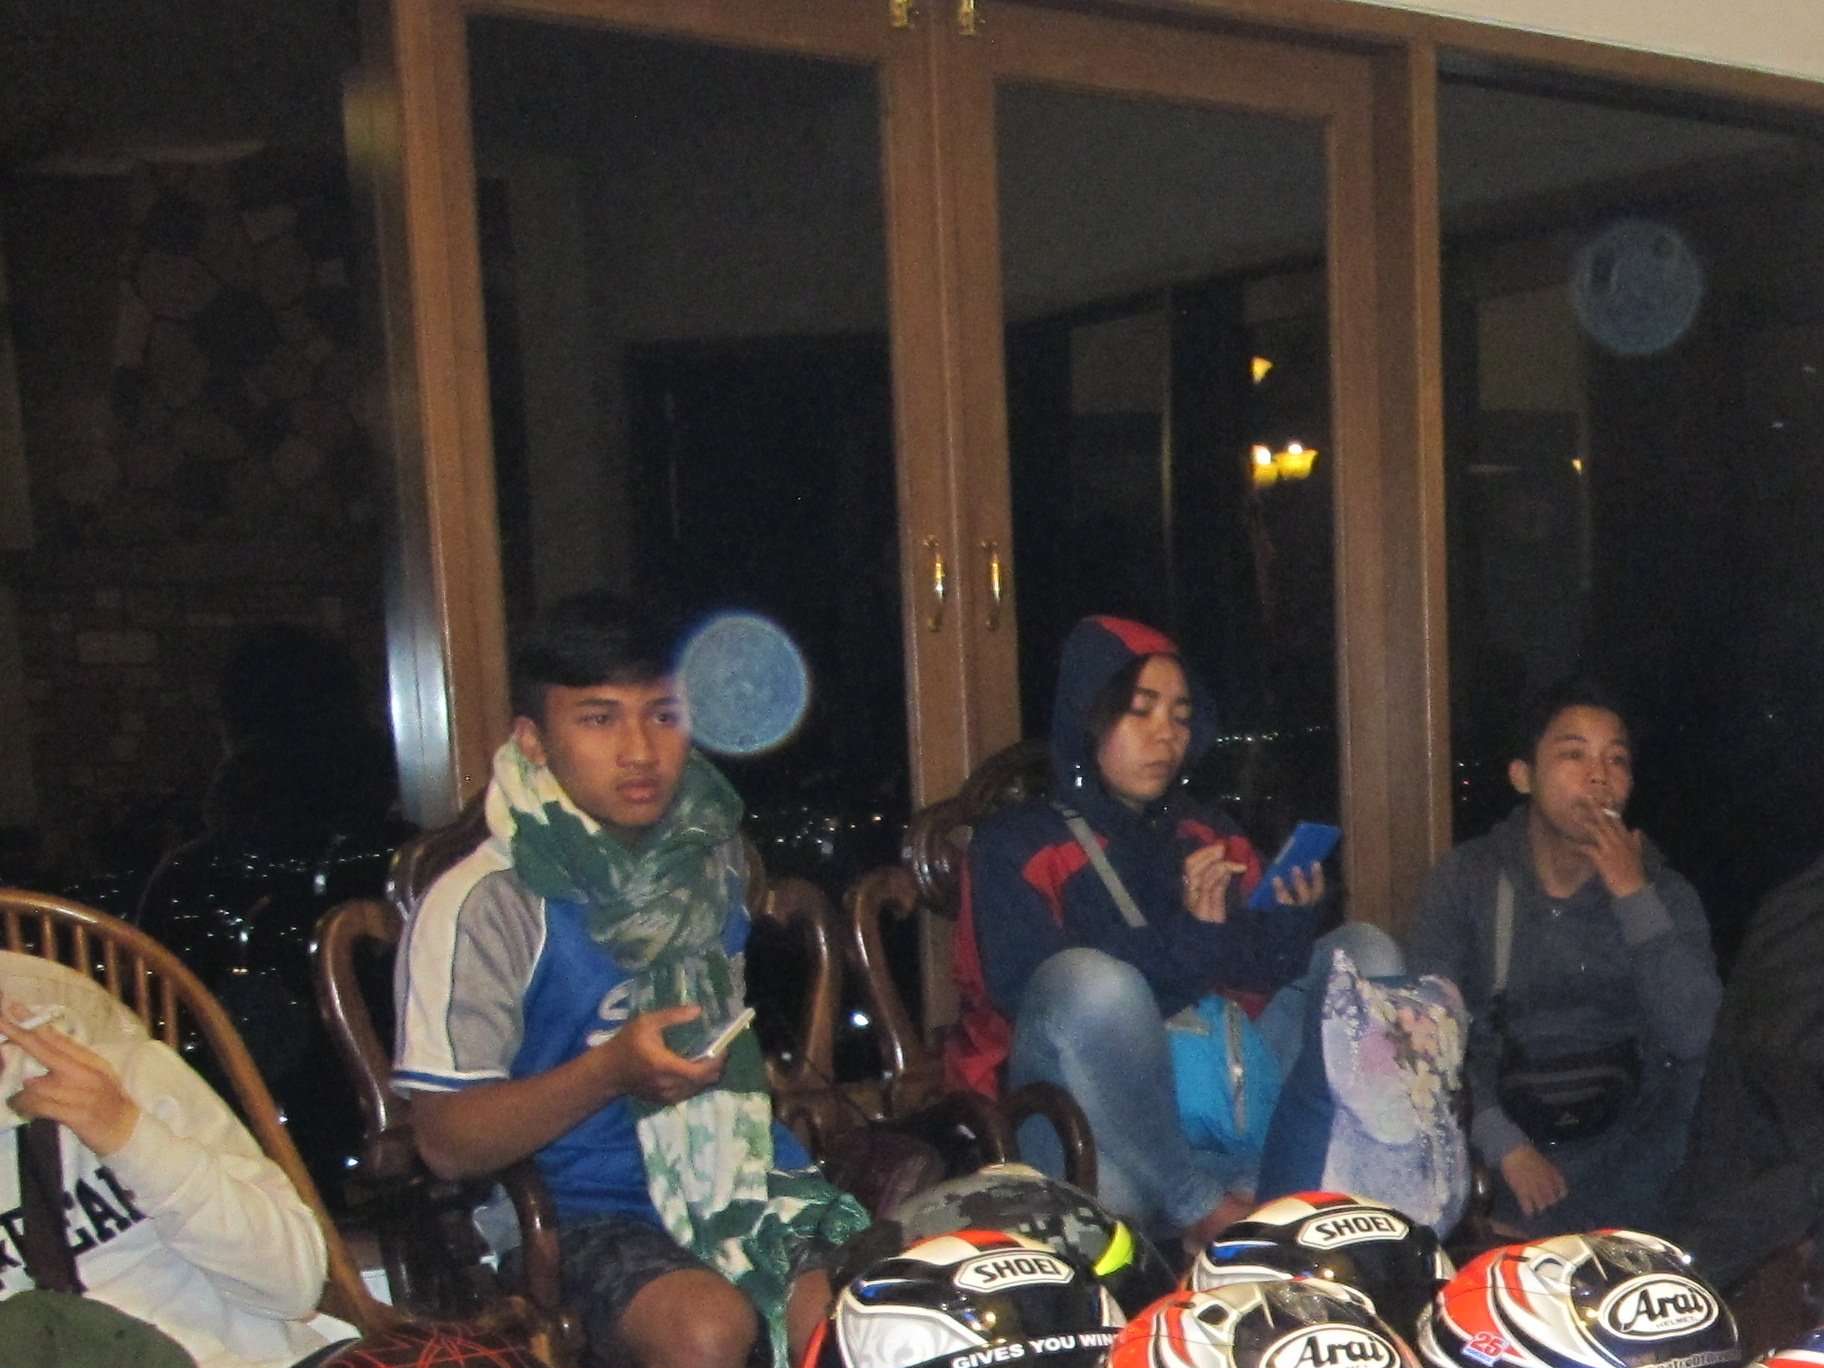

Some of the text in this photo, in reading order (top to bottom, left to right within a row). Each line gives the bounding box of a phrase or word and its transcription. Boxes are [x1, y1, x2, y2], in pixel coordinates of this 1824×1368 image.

[1316, 1216, 1397, 1241] SHOEI
[974, 1256, 1061, 1284] SHOEI
[1620, 1286, 1703, 1333] Arai
[1028, 1335, 1075, 1354] YOU
